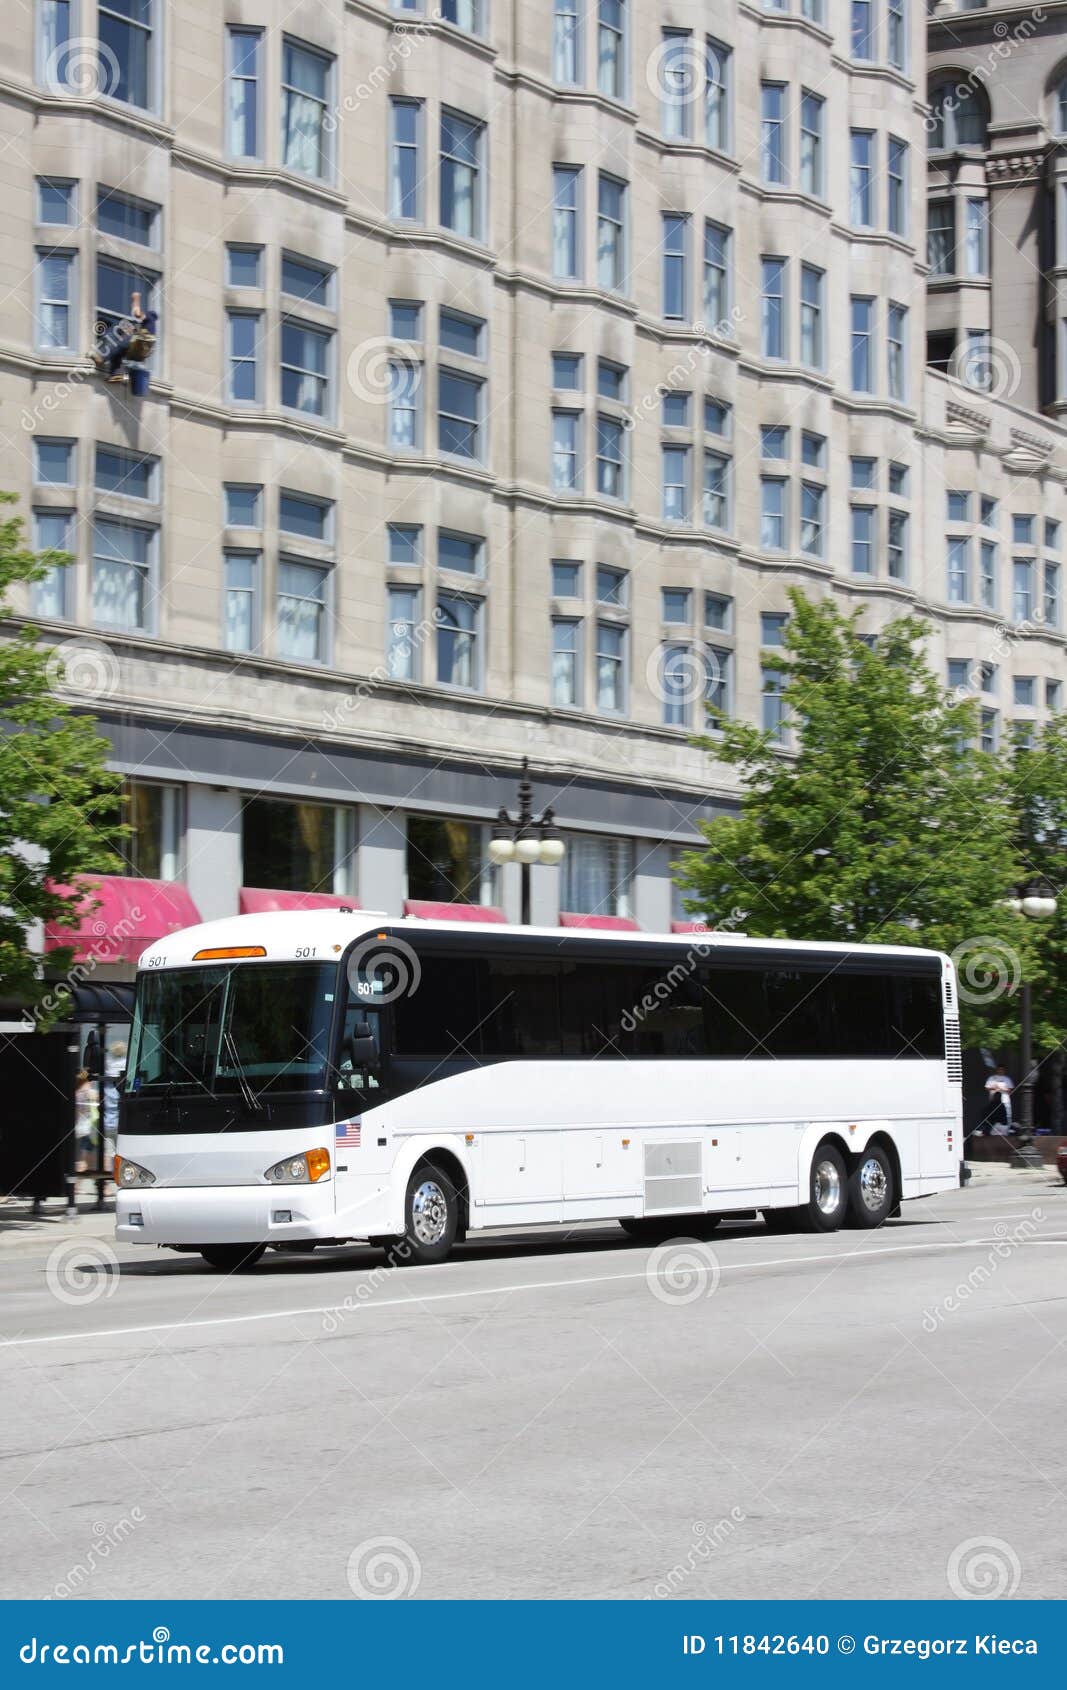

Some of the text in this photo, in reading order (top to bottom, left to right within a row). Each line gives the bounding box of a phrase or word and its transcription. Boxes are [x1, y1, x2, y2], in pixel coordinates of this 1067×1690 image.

[295, 947, 317, 958] 501
[148, 956, 168, 967] 501
[357, 982, 374, 995] 501
